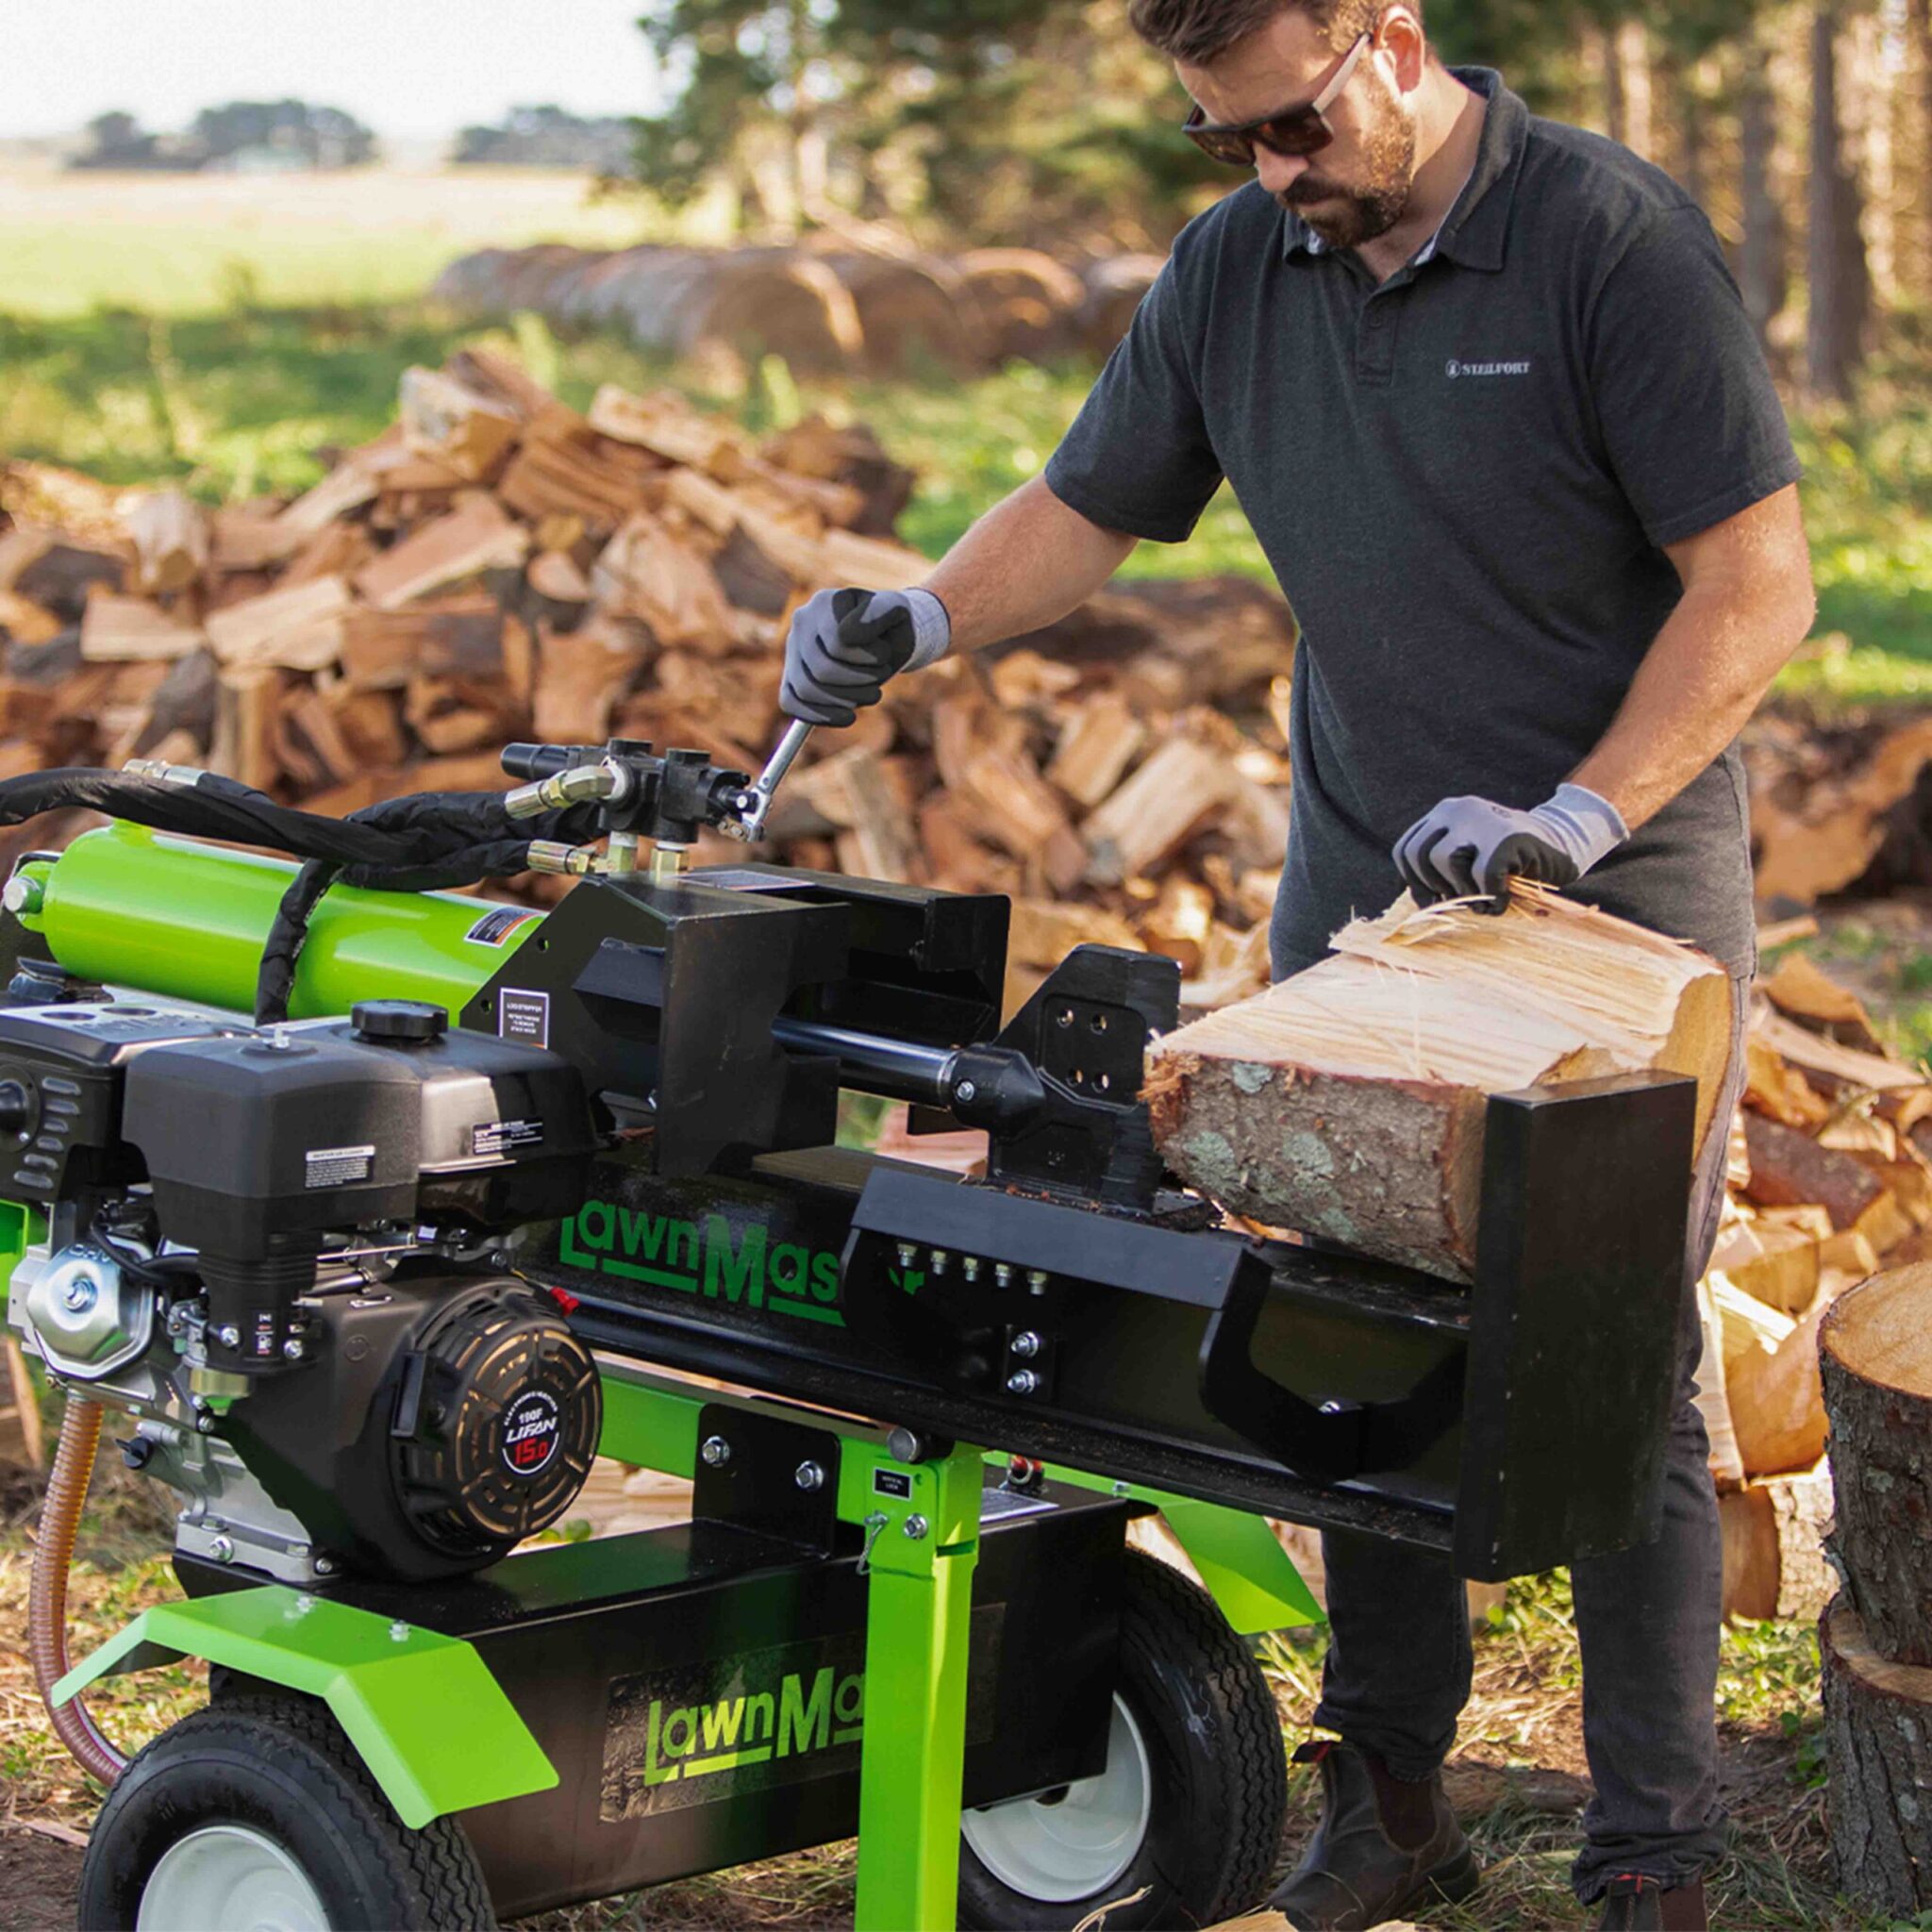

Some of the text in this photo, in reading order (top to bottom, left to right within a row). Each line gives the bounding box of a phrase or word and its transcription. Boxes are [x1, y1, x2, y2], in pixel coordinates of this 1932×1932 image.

[506, 1416, 558, 1444] LIFAN
[514, 1438, 550, 1466] 15.0
[644, 1666, 866, 1787] LawnMa
